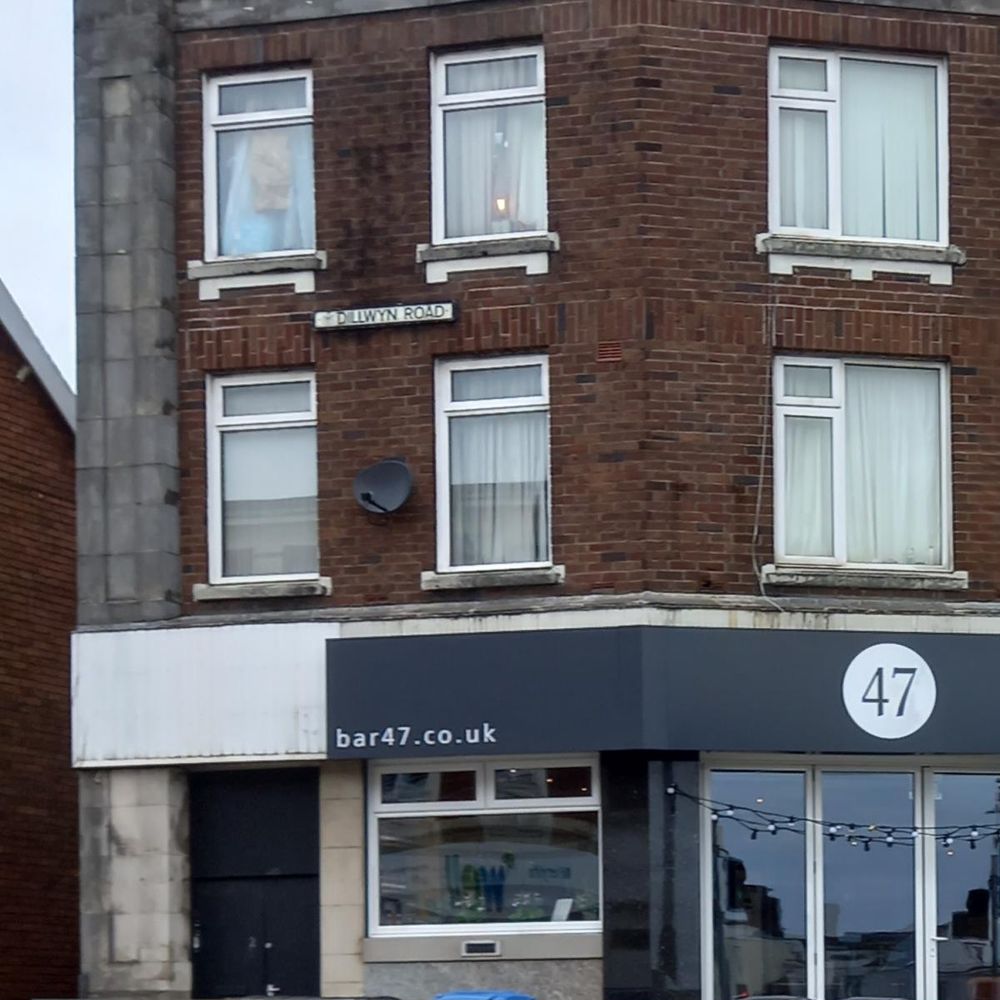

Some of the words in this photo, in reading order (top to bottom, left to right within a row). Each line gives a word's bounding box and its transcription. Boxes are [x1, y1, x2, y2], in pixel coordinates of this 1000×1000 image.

[336, 308, 398, 325] DILLWYN
[403, 305, 445, 320] ROAD
[861, 666, 918, 717] 47
[335, 722, 497, 748] bar47.co.uk
